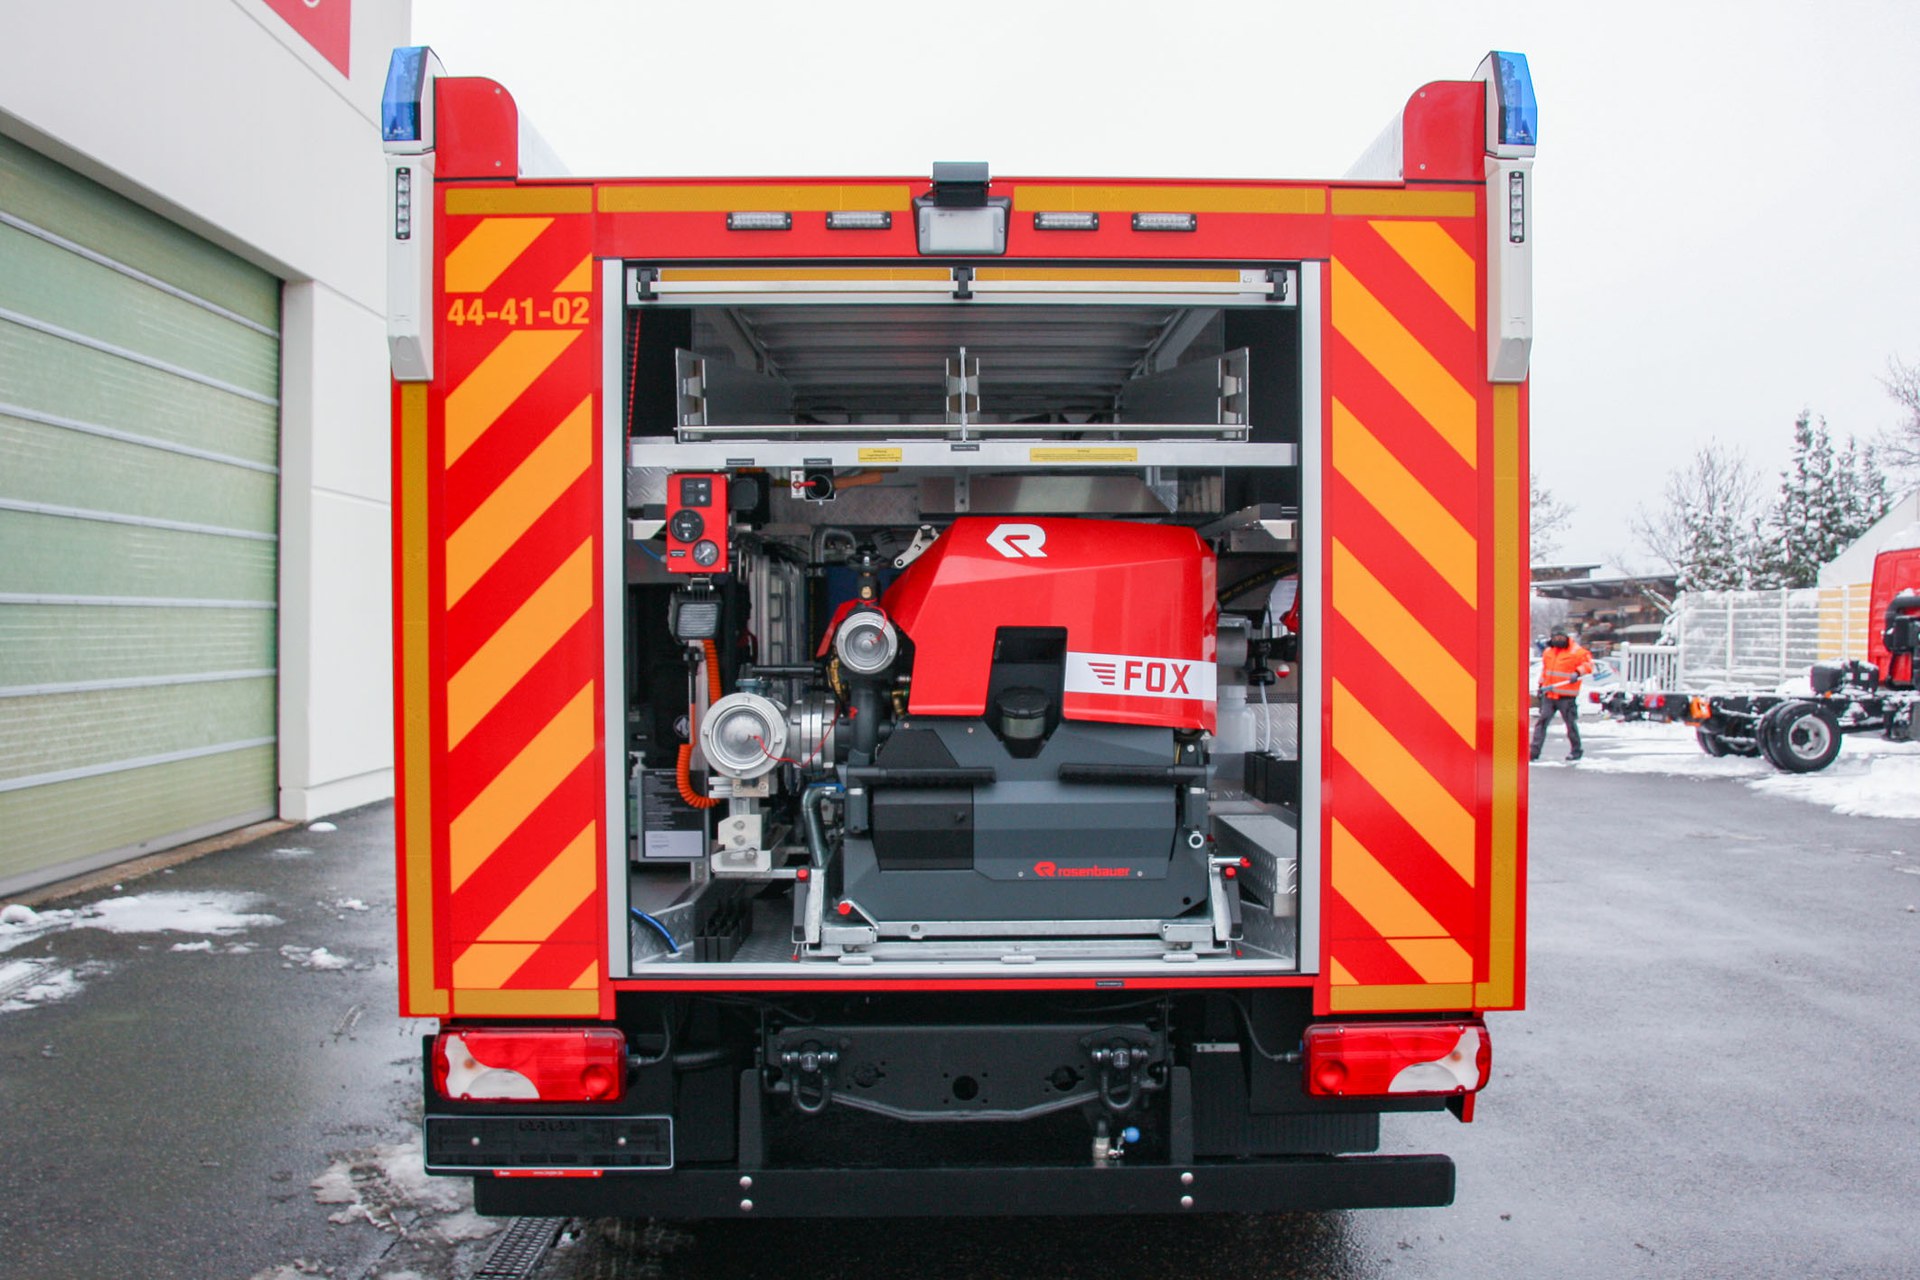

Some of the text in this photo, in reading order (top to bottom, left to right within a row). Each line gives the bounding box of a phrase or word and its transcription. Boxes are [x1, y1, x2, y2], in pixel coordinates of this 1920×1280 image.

[447, 296, 590, 327] 44-41-02
[1123, 660, 1191, 695] FOX
[1057, 864, 1131, 877] rosenbauer
